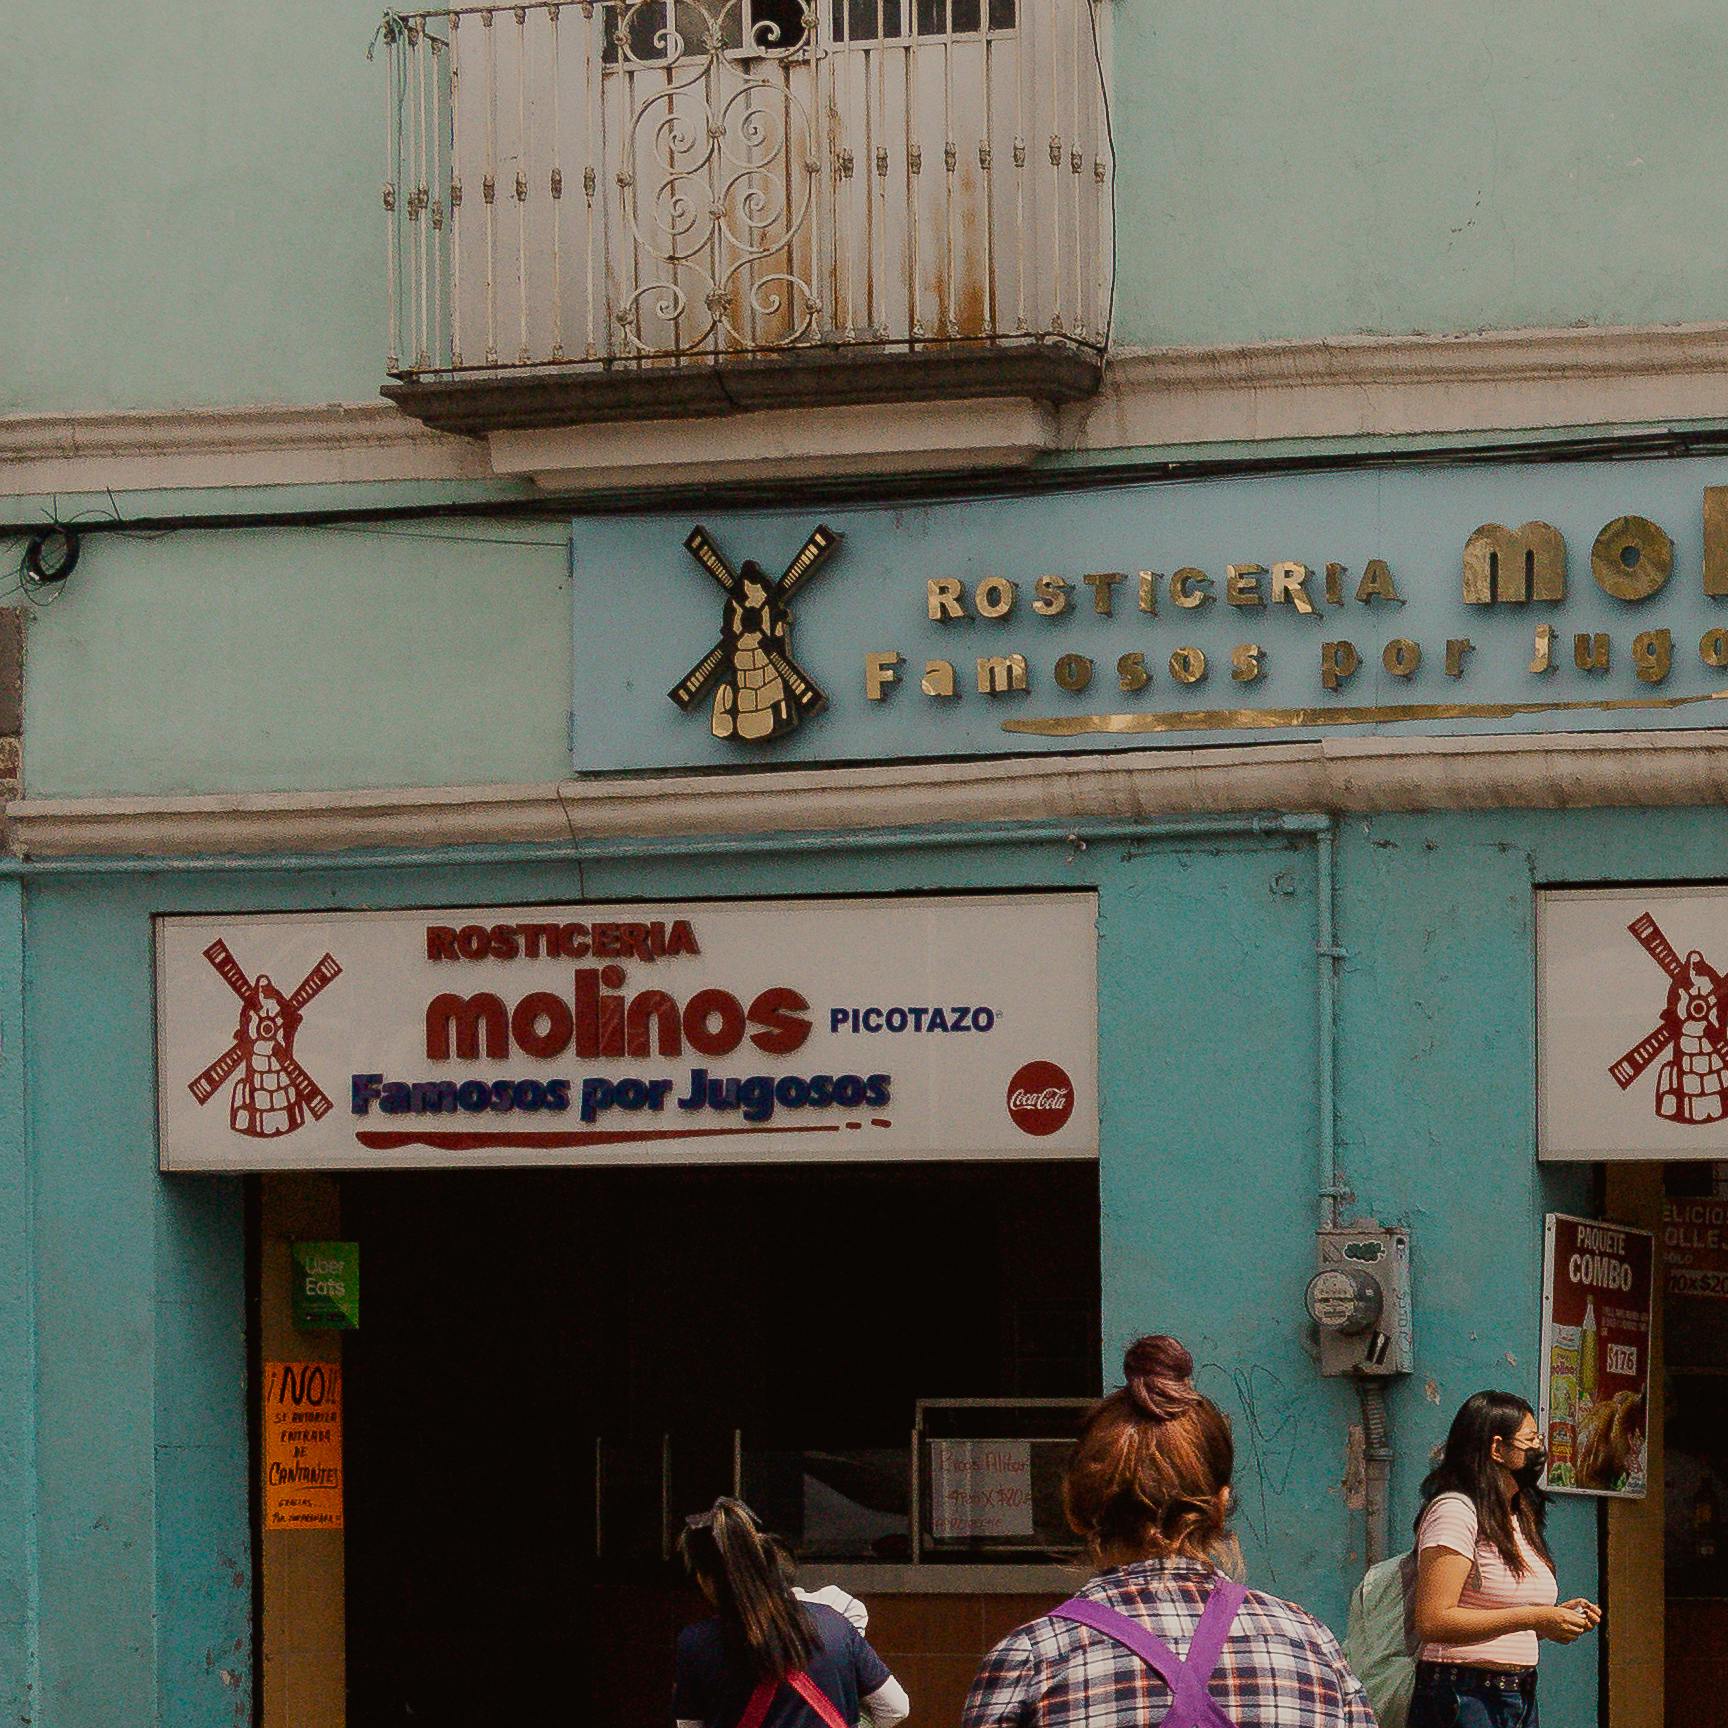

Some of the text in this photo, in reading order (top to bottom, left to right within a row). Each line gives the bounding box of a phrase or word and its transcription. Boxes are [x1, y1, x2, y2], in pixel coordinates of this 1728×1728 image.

[926, 558, 1404, 621] ROSTICERIA
[865, 643, 1262, 700] Famosos
[1321, 637, 1475, 691] por
[426, 921, 699, 962] ROSTICERIA
[426, 964, 812, 1060] molinos
[351, 1069, 892, 1123] Famosos por Jugosos
[1577, 1225, 1626, 1256] PAQUETE
[304, 1257, 345, 1275] Uber
[1568, 1254, 1632, 1292] COMBO
[305, 1277, 346, 1297] Eats
[1608, 1345, 1634, 1373] $176
[281, 1430, 330, 1442] ENTRADA
